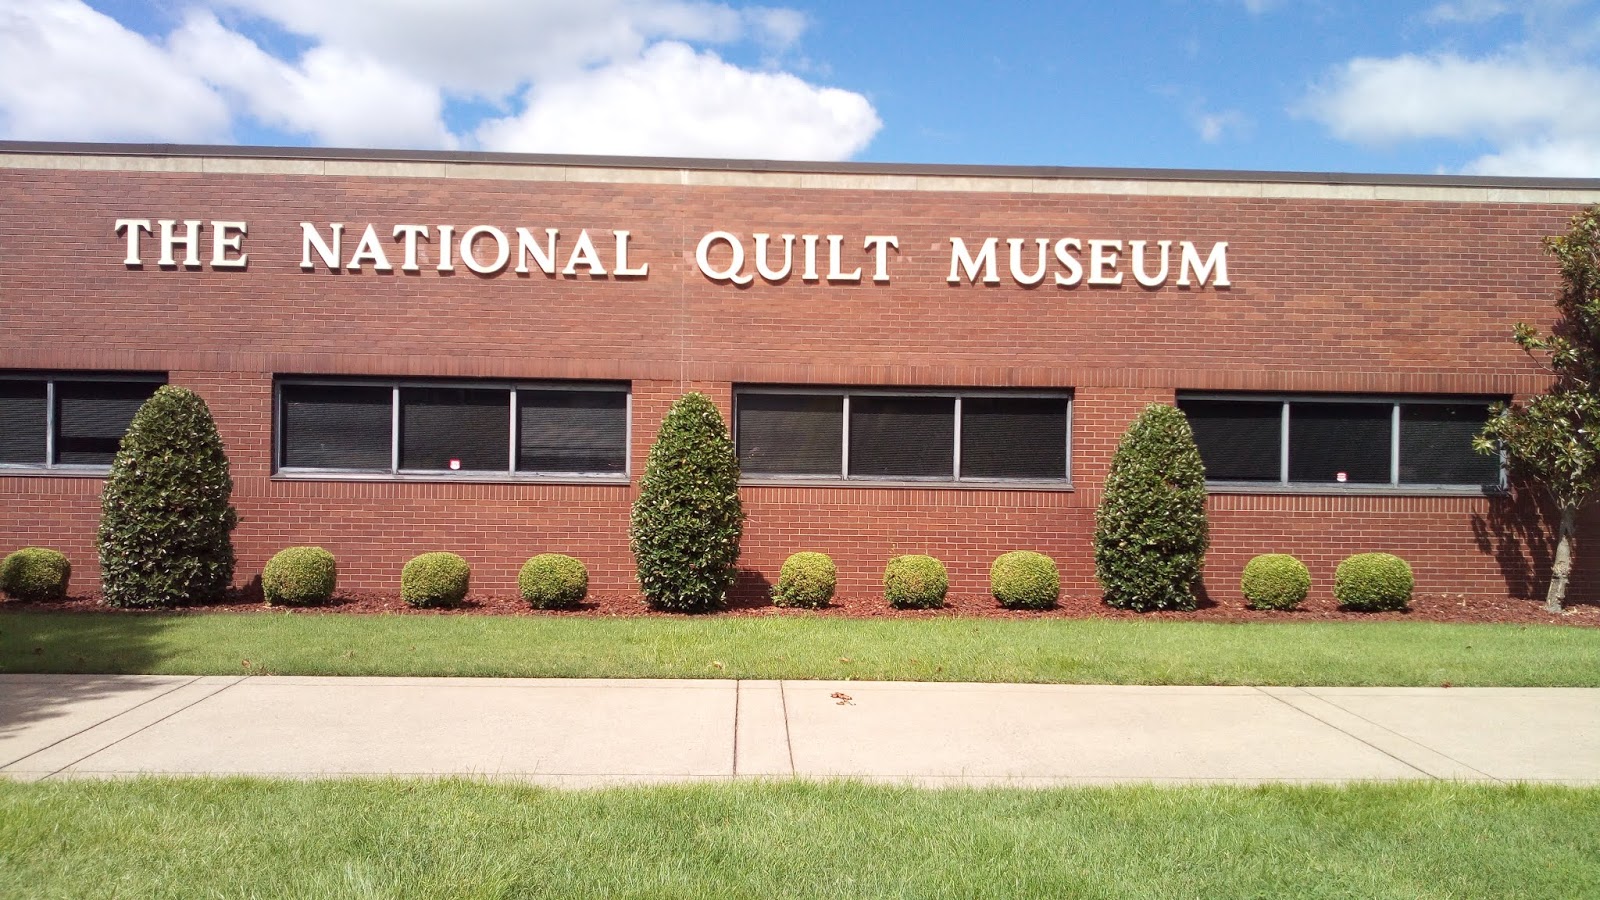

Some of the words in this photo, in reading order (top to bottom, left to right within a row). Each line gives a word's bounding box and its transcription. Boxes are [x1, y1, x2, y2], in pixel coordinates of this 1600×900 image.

[115, 218, 248, 268] THE
[300, 222, 649, 277] NATIONAL
[695, 230, 900, 285] QUILT
[946, 236, 1232, 287] MUSEUM
